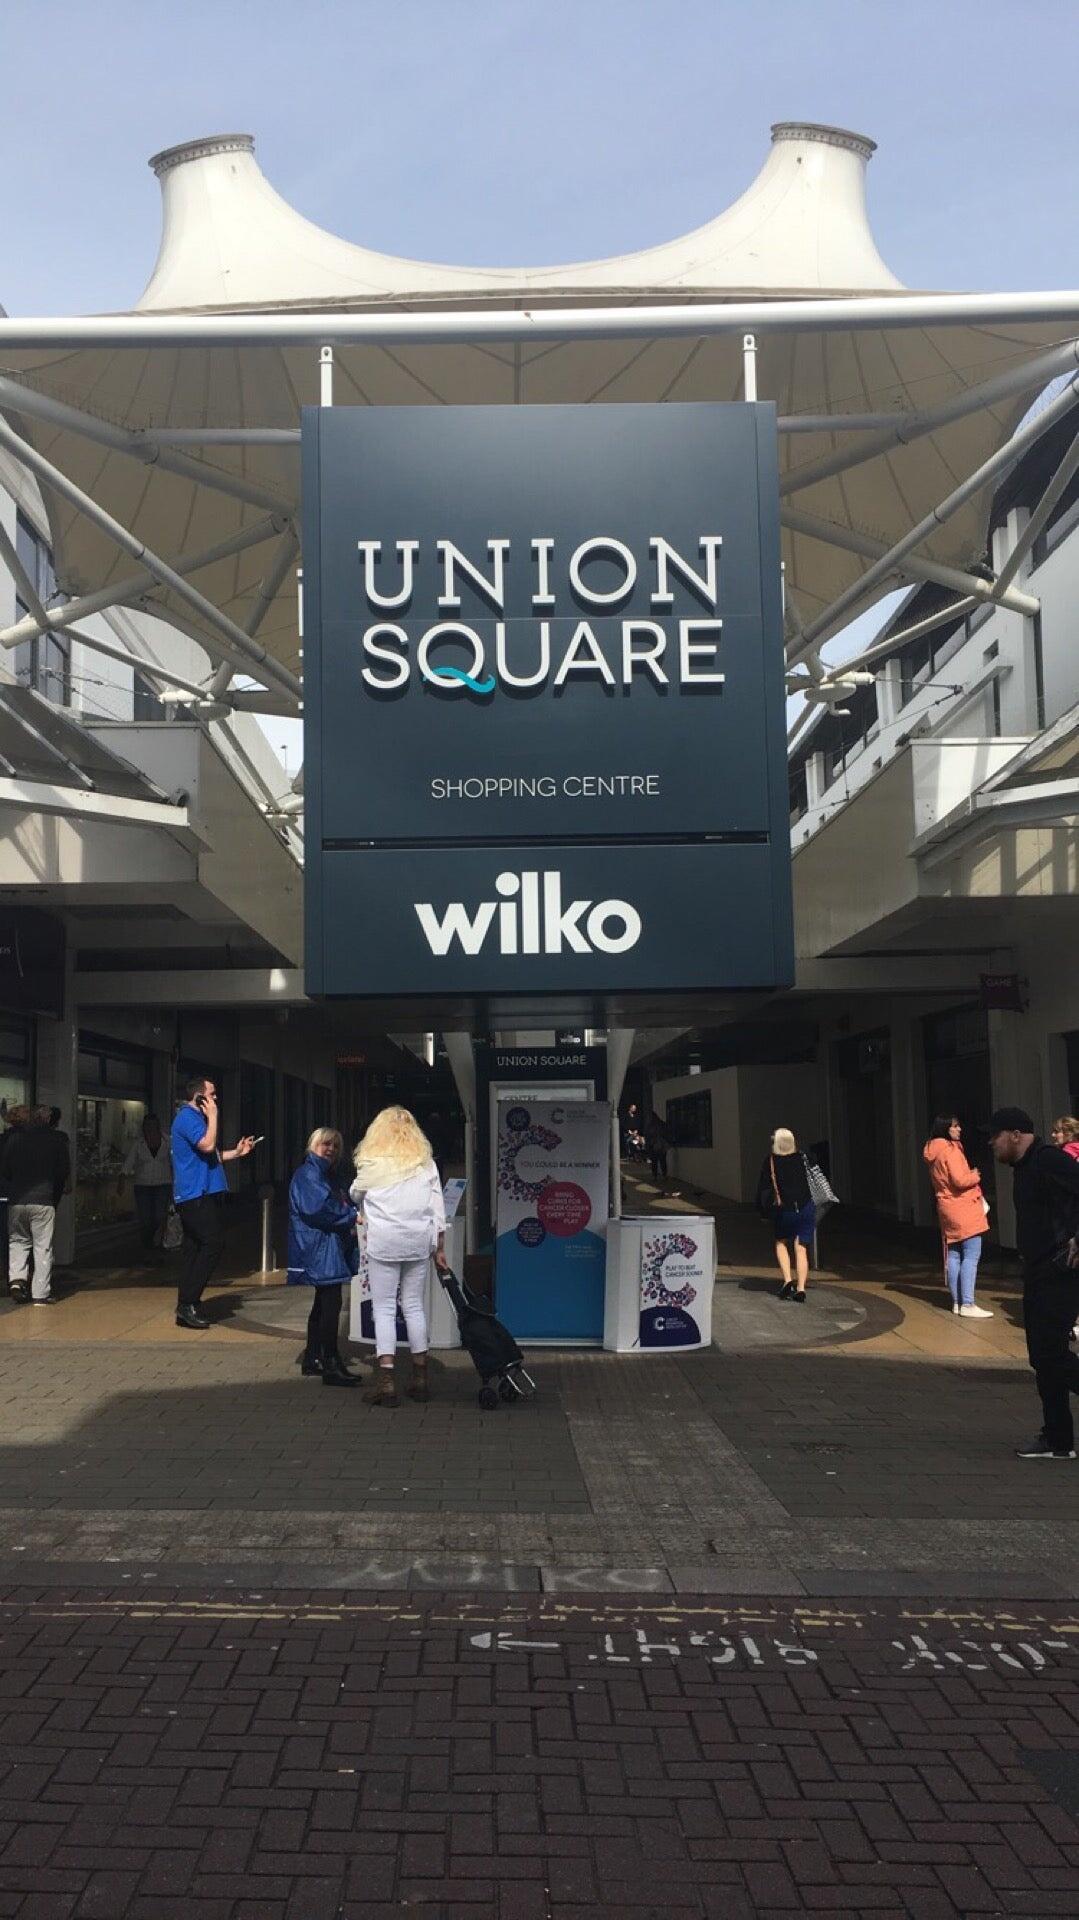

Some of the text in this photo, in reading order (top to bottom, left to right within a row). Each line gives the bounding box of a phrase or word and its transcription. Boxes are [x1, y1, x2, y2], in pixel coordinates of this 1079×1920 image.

[358, 536, 723, 610] UNION
[362, 619, 726, 694] SQUARE
[431, 774, 660, 800] SHOPPING CENTRE
[414, 870, 643, 956] wilko
[497, 1054, 587, 1066] UNION SQUARE
[588, 1629, 818, 1666] RIGHT
